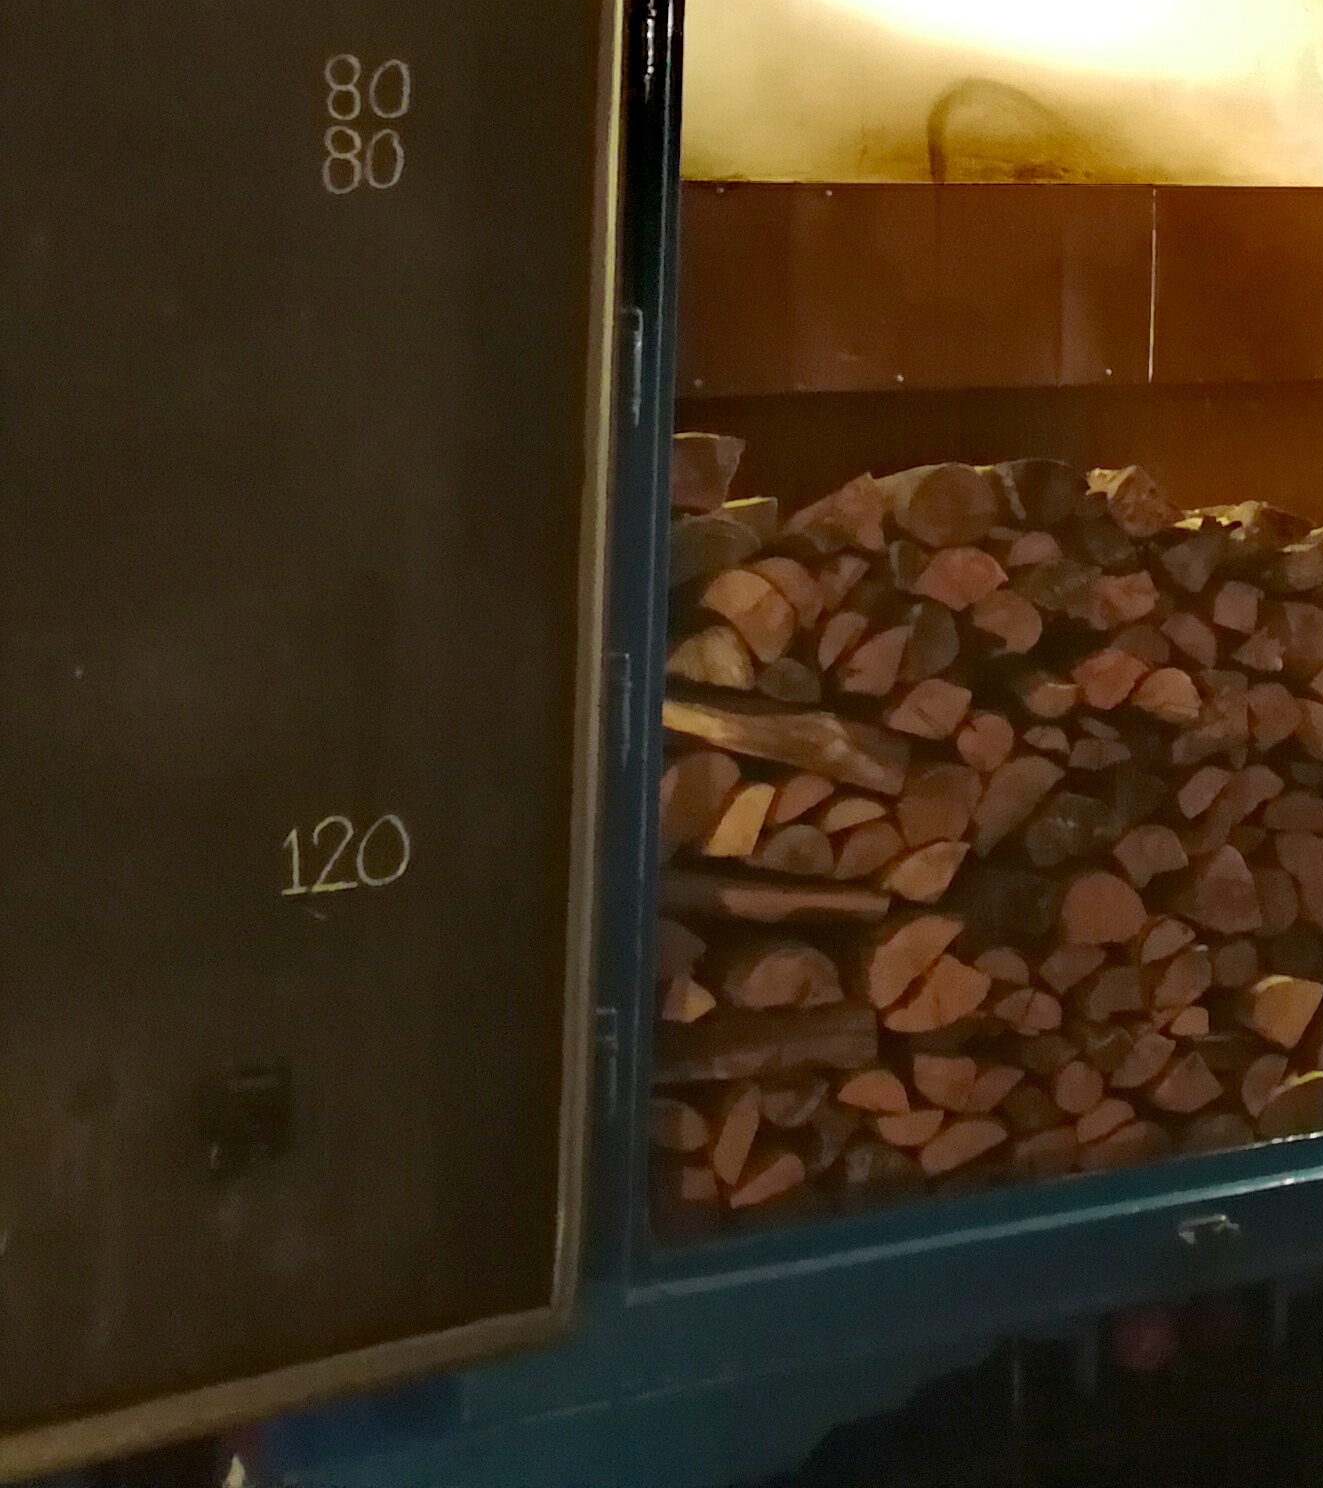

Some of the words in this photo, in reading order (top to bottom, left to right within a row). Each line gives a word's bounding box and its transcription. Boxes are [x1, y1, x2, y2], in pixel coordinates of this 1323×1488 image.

[324, 53, 410, 120] 80
[322, 125, 405, 194] 80
[281, 814, 411, 896] 120
